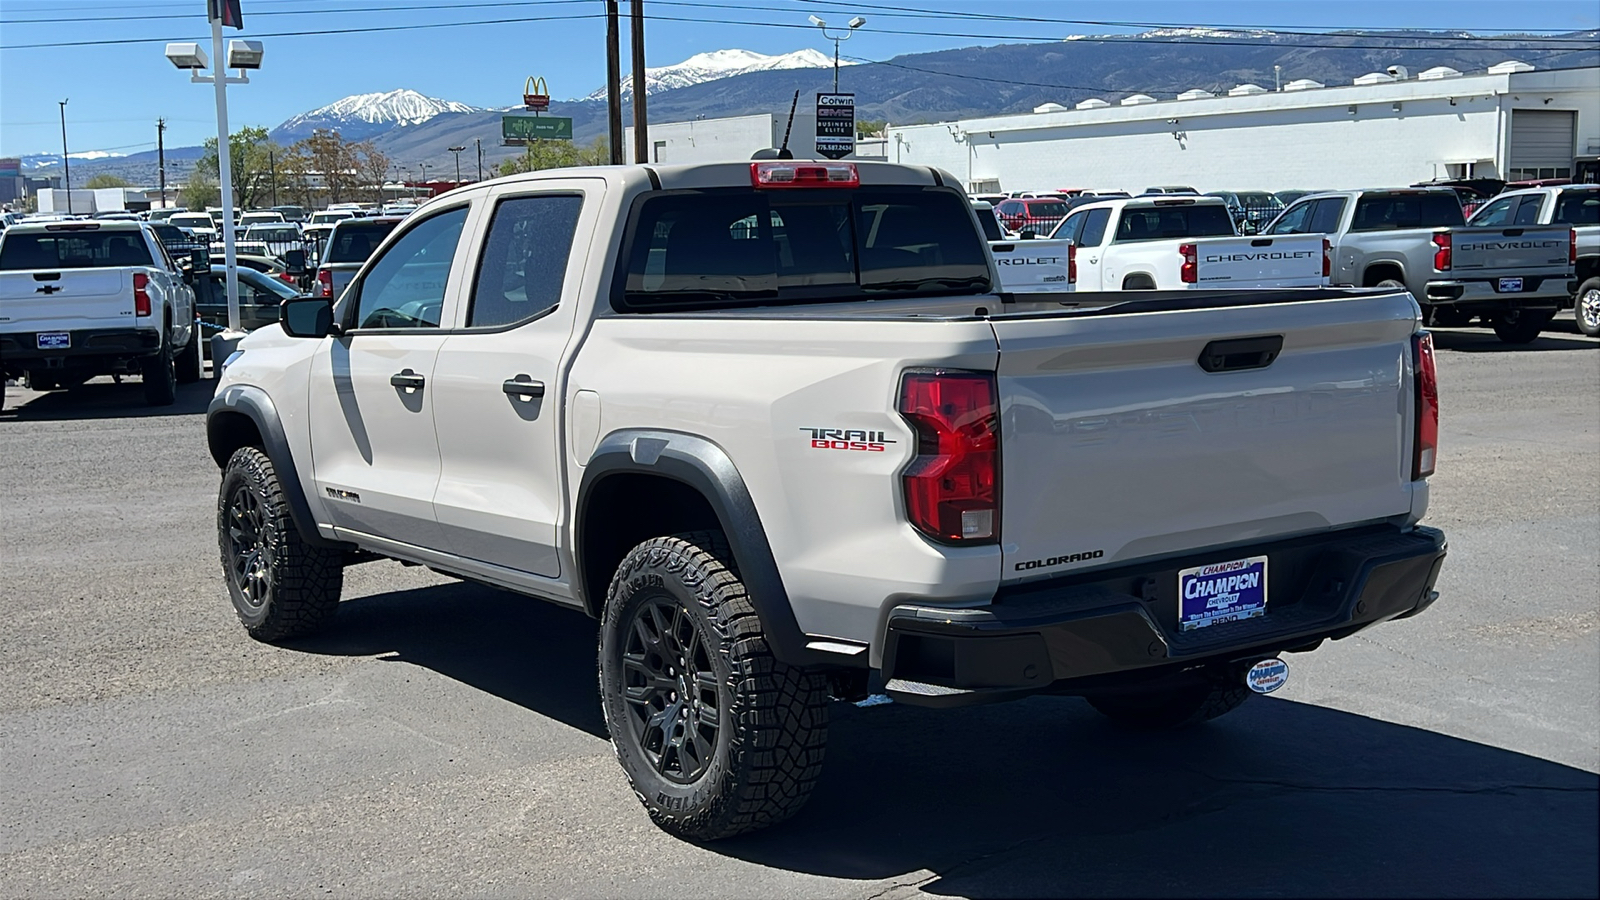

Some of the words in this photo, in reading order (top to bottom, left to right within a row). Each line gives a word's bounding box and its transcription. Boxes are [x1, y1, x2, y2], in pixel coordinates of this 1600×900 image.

[821, 96, 854, 105] Corwin
[818, 108, 852, 116] GMC
[1461, 241, 1562, 251] CHEVROLET
[1207, 251, 1315, 263] CHEVROLET
[799, 428, 897, 443] TRAIL
[811, 439, 885, 451] BOSS
[1015, 549, 1104, 571] COLORADO
[1203, 560, 1245, 575] CHAMPION
[1185, 572, 1260, 600] CHAMPION
[1208, 594, 1238, 606] CHEVROLET
